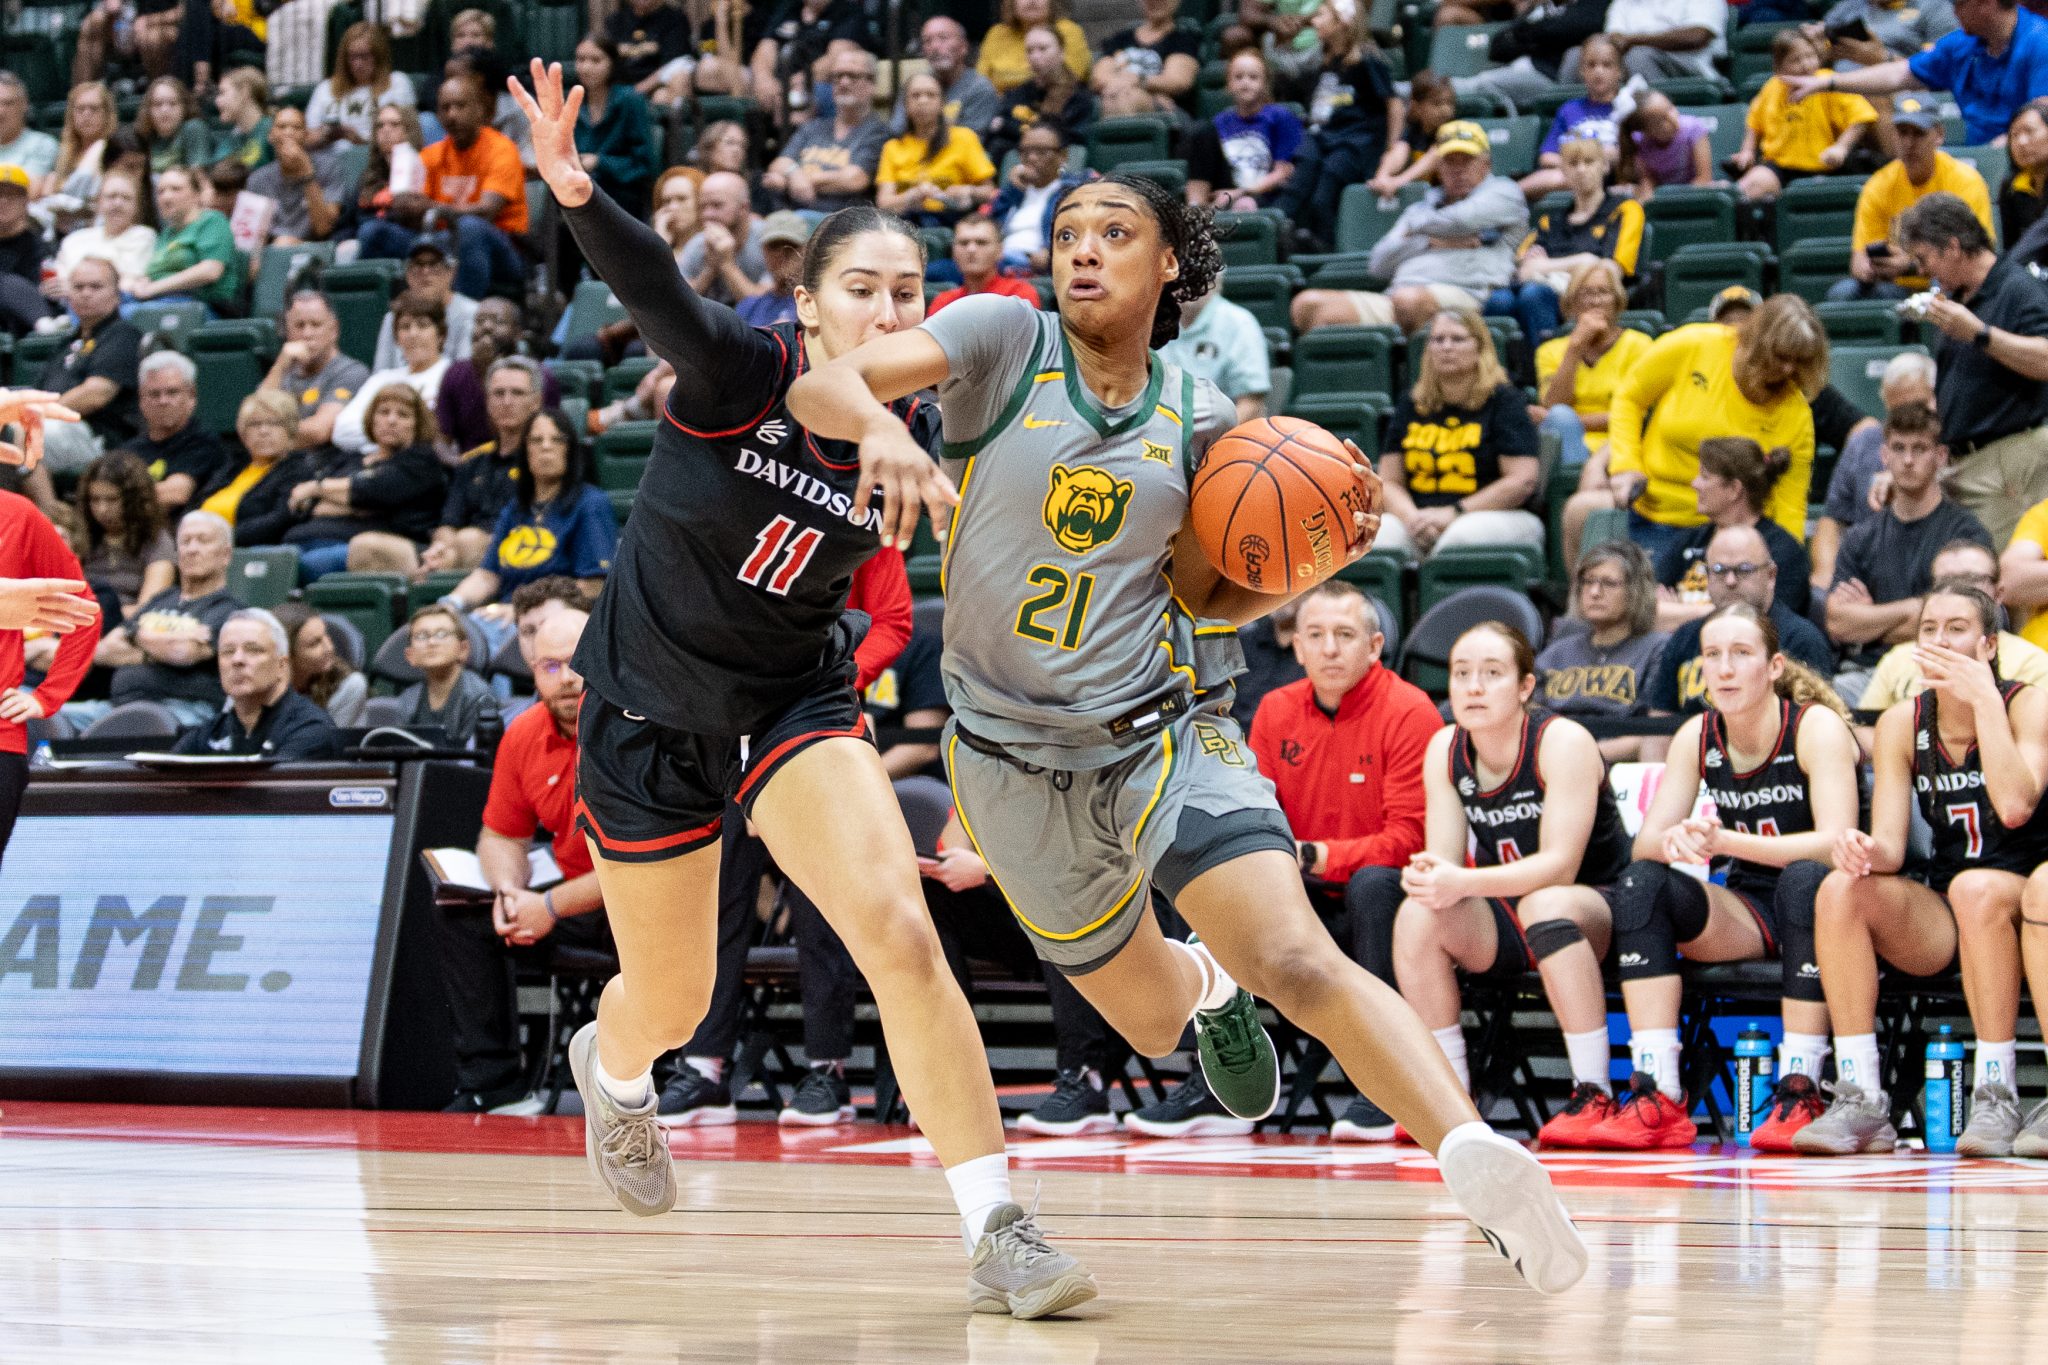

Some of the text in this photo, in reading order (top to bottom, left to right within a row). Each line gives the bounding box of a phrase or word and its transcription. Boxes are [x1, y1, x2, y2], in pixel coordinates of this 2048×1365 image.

[1405, 450, 1477, 493] 22
[736, 514, 825, 597] 11
[1013, 564, 1096, 652] 21
[1161, 699, 1175, 712] 44
[1545, 665, 1636, 705] IOWA
[1193, 721, 1246, 767] BU
[1946, 802, 1983, 859] 7
[1738, 1058, 1750, 1133] POWERADE
[1951, 1060, 1963, 1136] POWERADE
